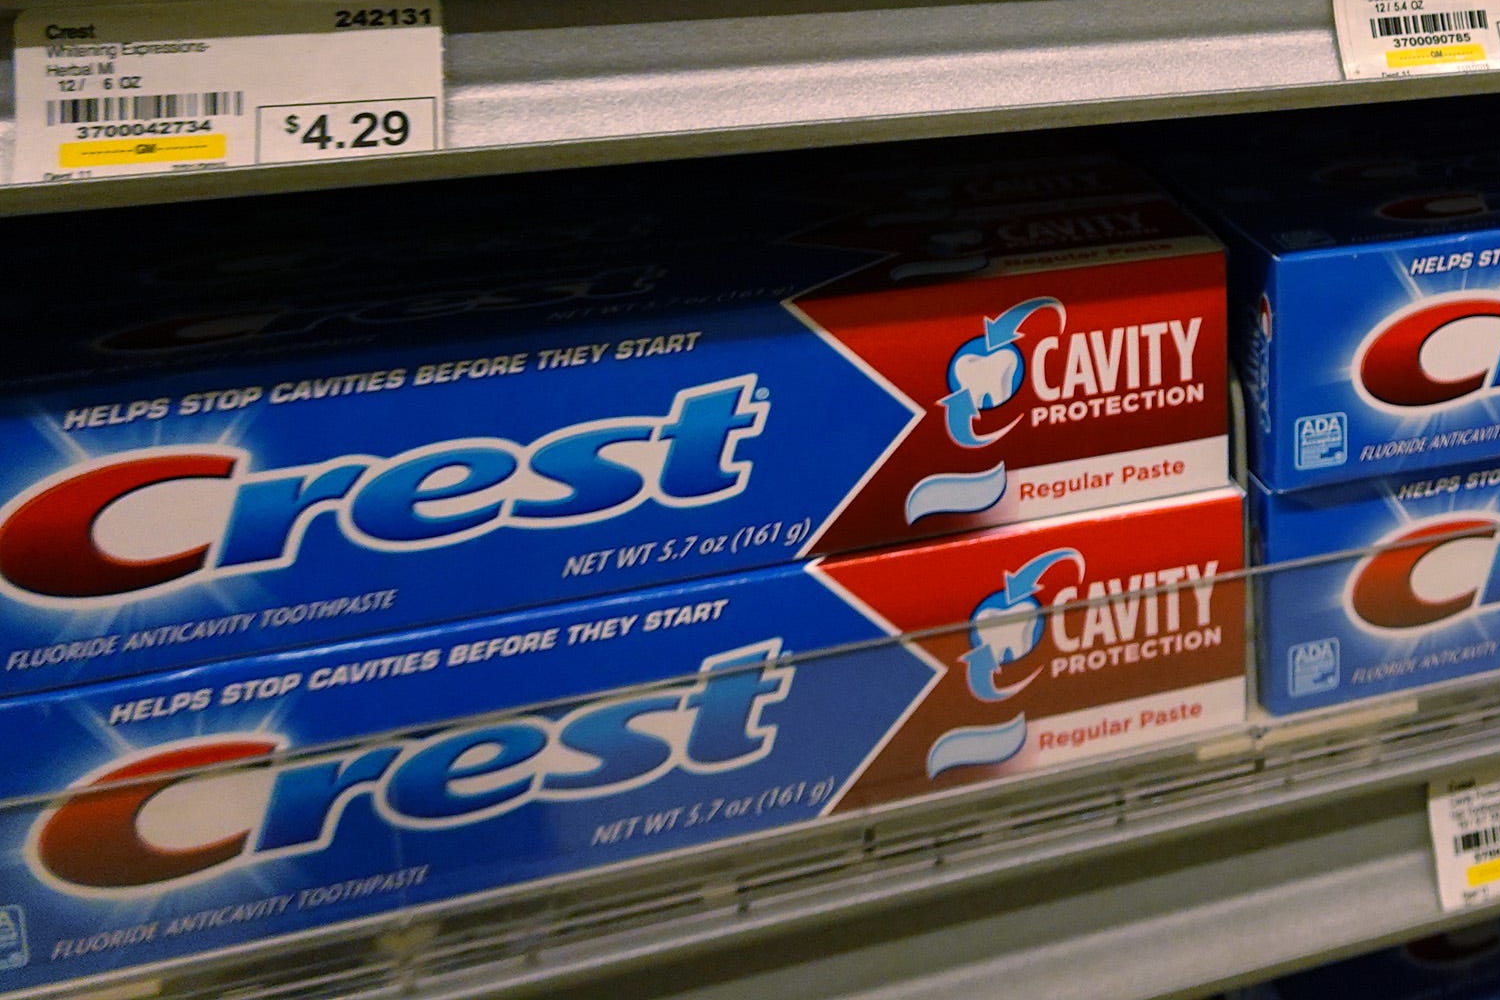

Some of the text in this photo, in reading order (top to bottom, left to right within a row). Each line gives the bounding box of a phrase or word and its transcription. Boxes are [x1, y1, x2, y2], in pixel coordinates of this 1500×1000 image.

[334, 8, 433, 29] 242131
[1411, 0, 1424, 11] OZ
[45, 23, 96, 41] Crest
[1393, 33, 1471, 49] 3700090785
[76, 119, 213, 140] 3700042734
[284, 110, 411, 151] $4.29
[1409, 251, 1475, 277] HELPS
[63, 331, 701, 431] HELPS STOP CAVITIES BEFORE THEY START
[1030, 317, 1203, 402] CAVITY
[1031, 383, 1205, 428] PROTECTION
[1301, 415, 1342, 436] ADA
[1360, 440, 1428, 461] FLUORIDE
[0, 379, 763, 599] Crest
[1019, 458, 1185, 501] Regular Paste
[1399, 476, 1462, 502] HELPS
[562, 517, 812, 578] NET WT 5.7 oz (161 g)
[1051, 561, 1220, 653] CAVITY
[6, 588, 400, 671] FLUORIDE ANTICAVITY TOOTHPASTE
[109, 599, 731, 725] HELPS STOP CAVITIES BEFORE THEY START
[1051, 626, 1223, 679] PROTECTION
[1038, 702, 1203, 750] Regular Paste
[36, 645, 788, 890] Crest
